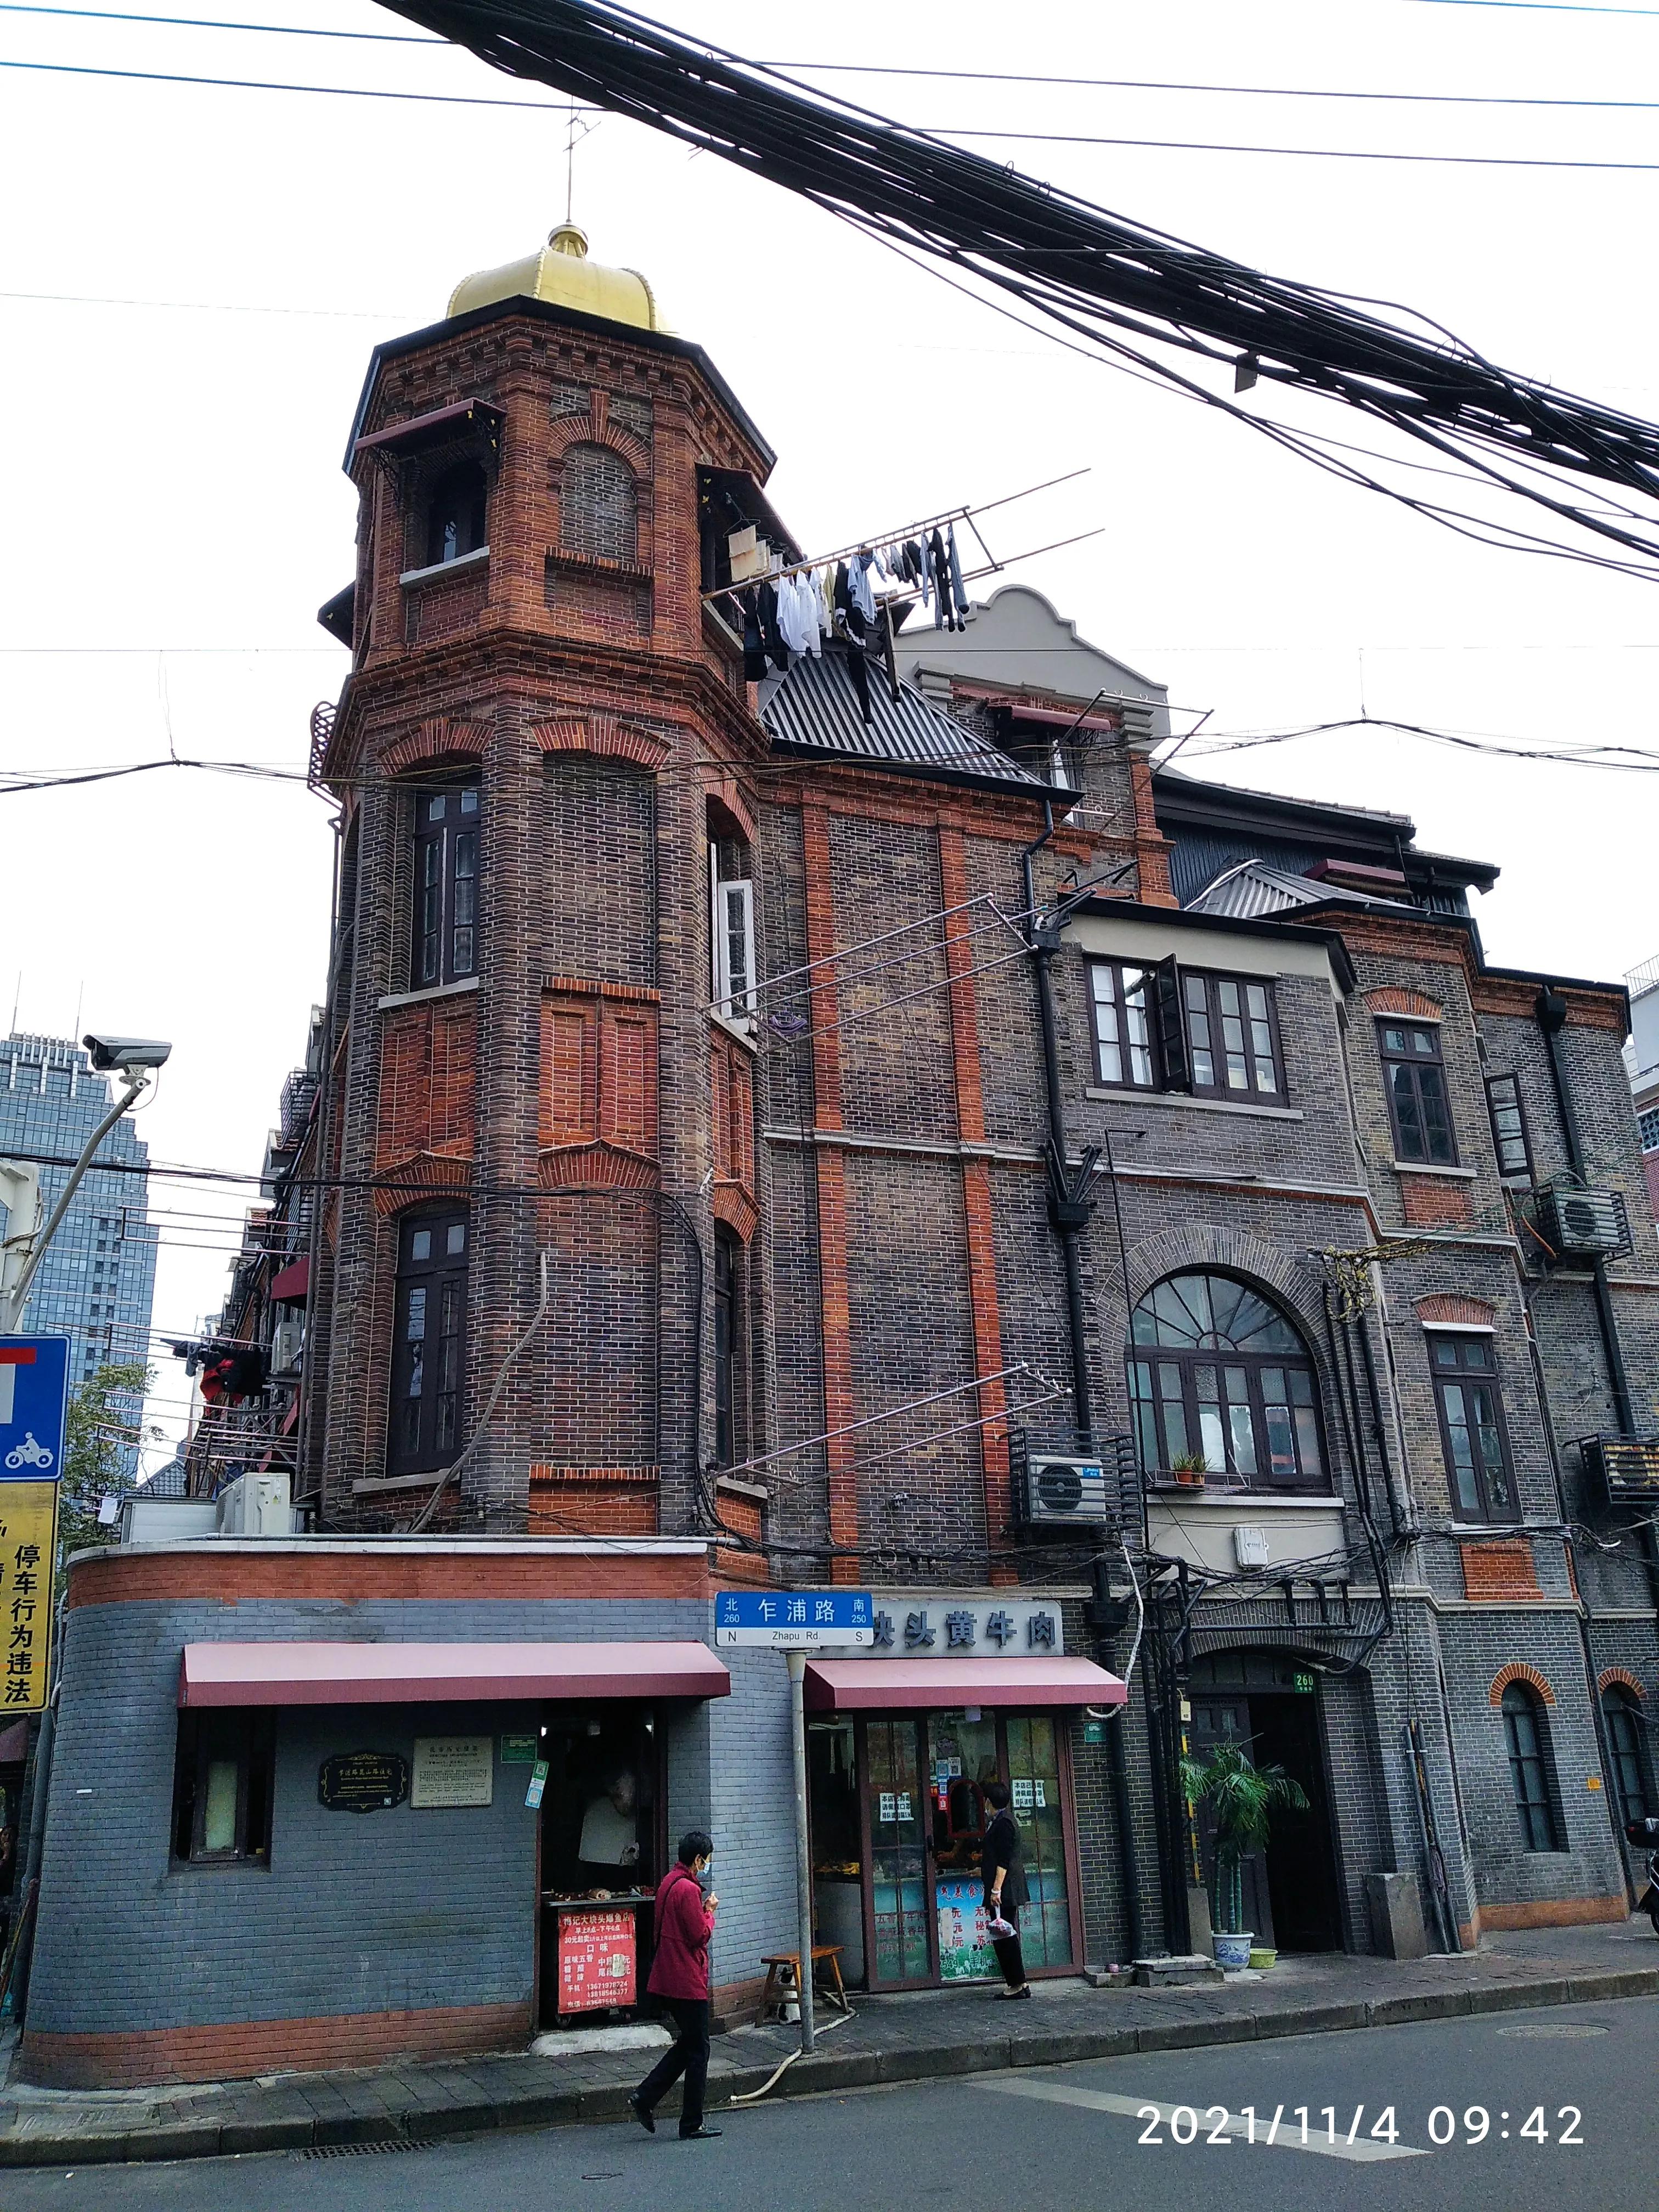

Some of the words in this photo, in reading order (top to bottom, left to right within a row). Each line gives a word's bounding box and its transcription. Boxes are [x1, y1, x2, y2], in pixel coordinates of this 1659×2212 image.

[725, 1598, 738, 1611] 北
[758, 1598, 835, 1622] 乍浦路
[854, 1598, 864, 1612] 南
[4, 1544, 41, 1703] 停车行为违法
[724, 1613, 740, 1623] 260
[851, 1614, 866, 1623] 250
[728, 1631, 736, 1641] N
[772, 1631, 800, 1642] Zhapu
[855, 1631, 863, 1642] S
[1296, 1675, 1313, 1686] 260
